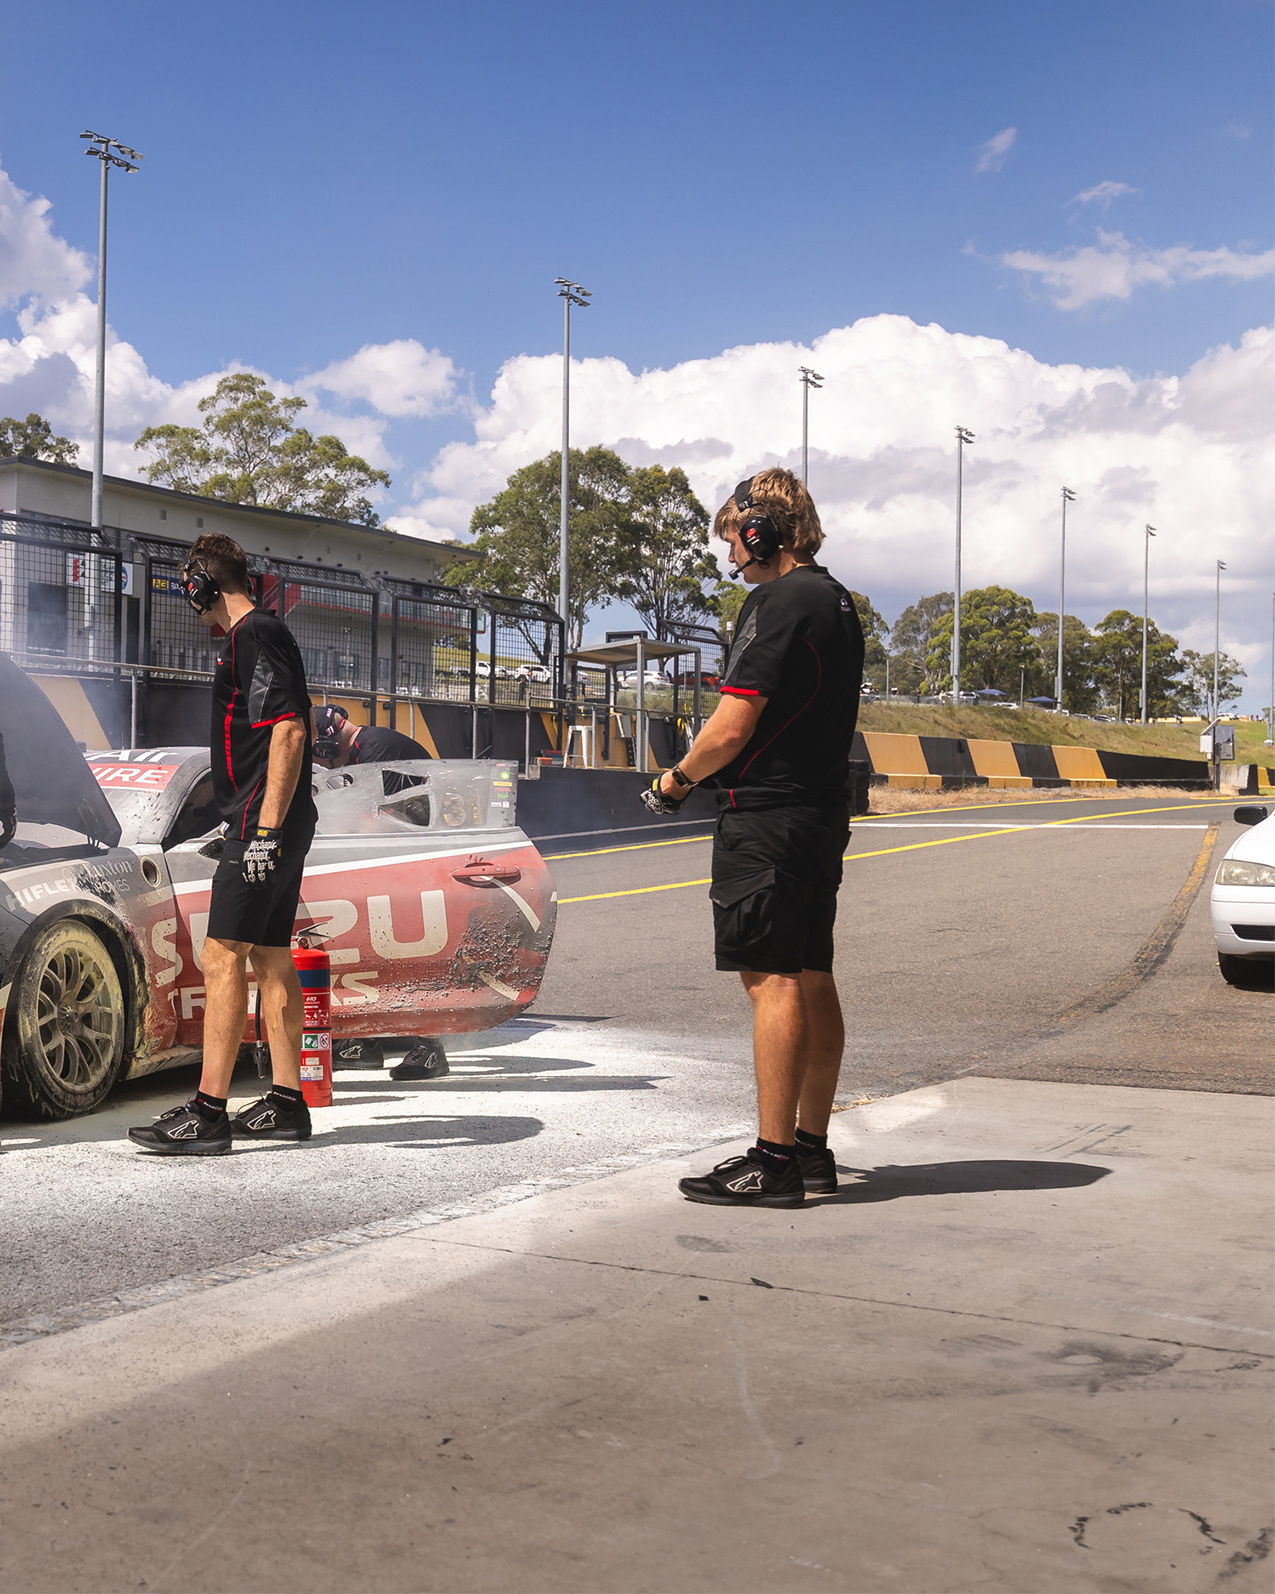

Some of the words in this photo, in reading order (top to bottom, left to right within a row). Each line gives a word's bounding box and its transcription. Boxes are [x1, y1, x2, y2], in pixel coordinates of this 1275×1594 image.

[83, 860, 133, 878] Luxton
[5, 877, 78, 912] HIFLEX
[95, 878, 131, 894] HOMES
